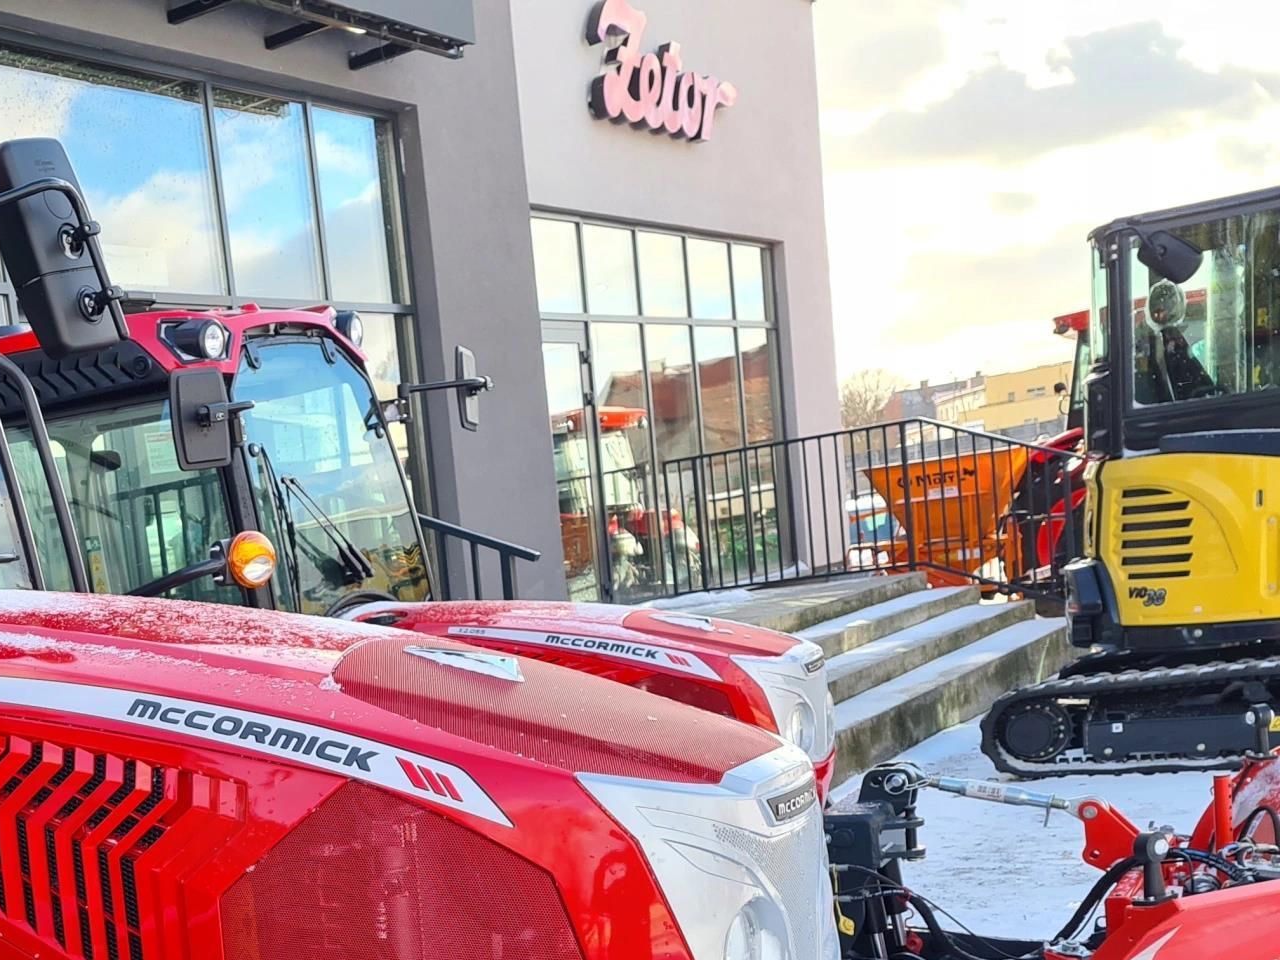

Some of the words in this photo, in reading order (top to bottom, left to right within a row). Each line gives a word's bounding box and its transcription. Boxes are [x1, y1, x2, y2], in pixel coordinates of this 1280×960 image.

[588, 0, 737, 141] Zetor
[545, 634, 660, 660] McCORMICK
[127, 698, 380, 773] McCORMICK
